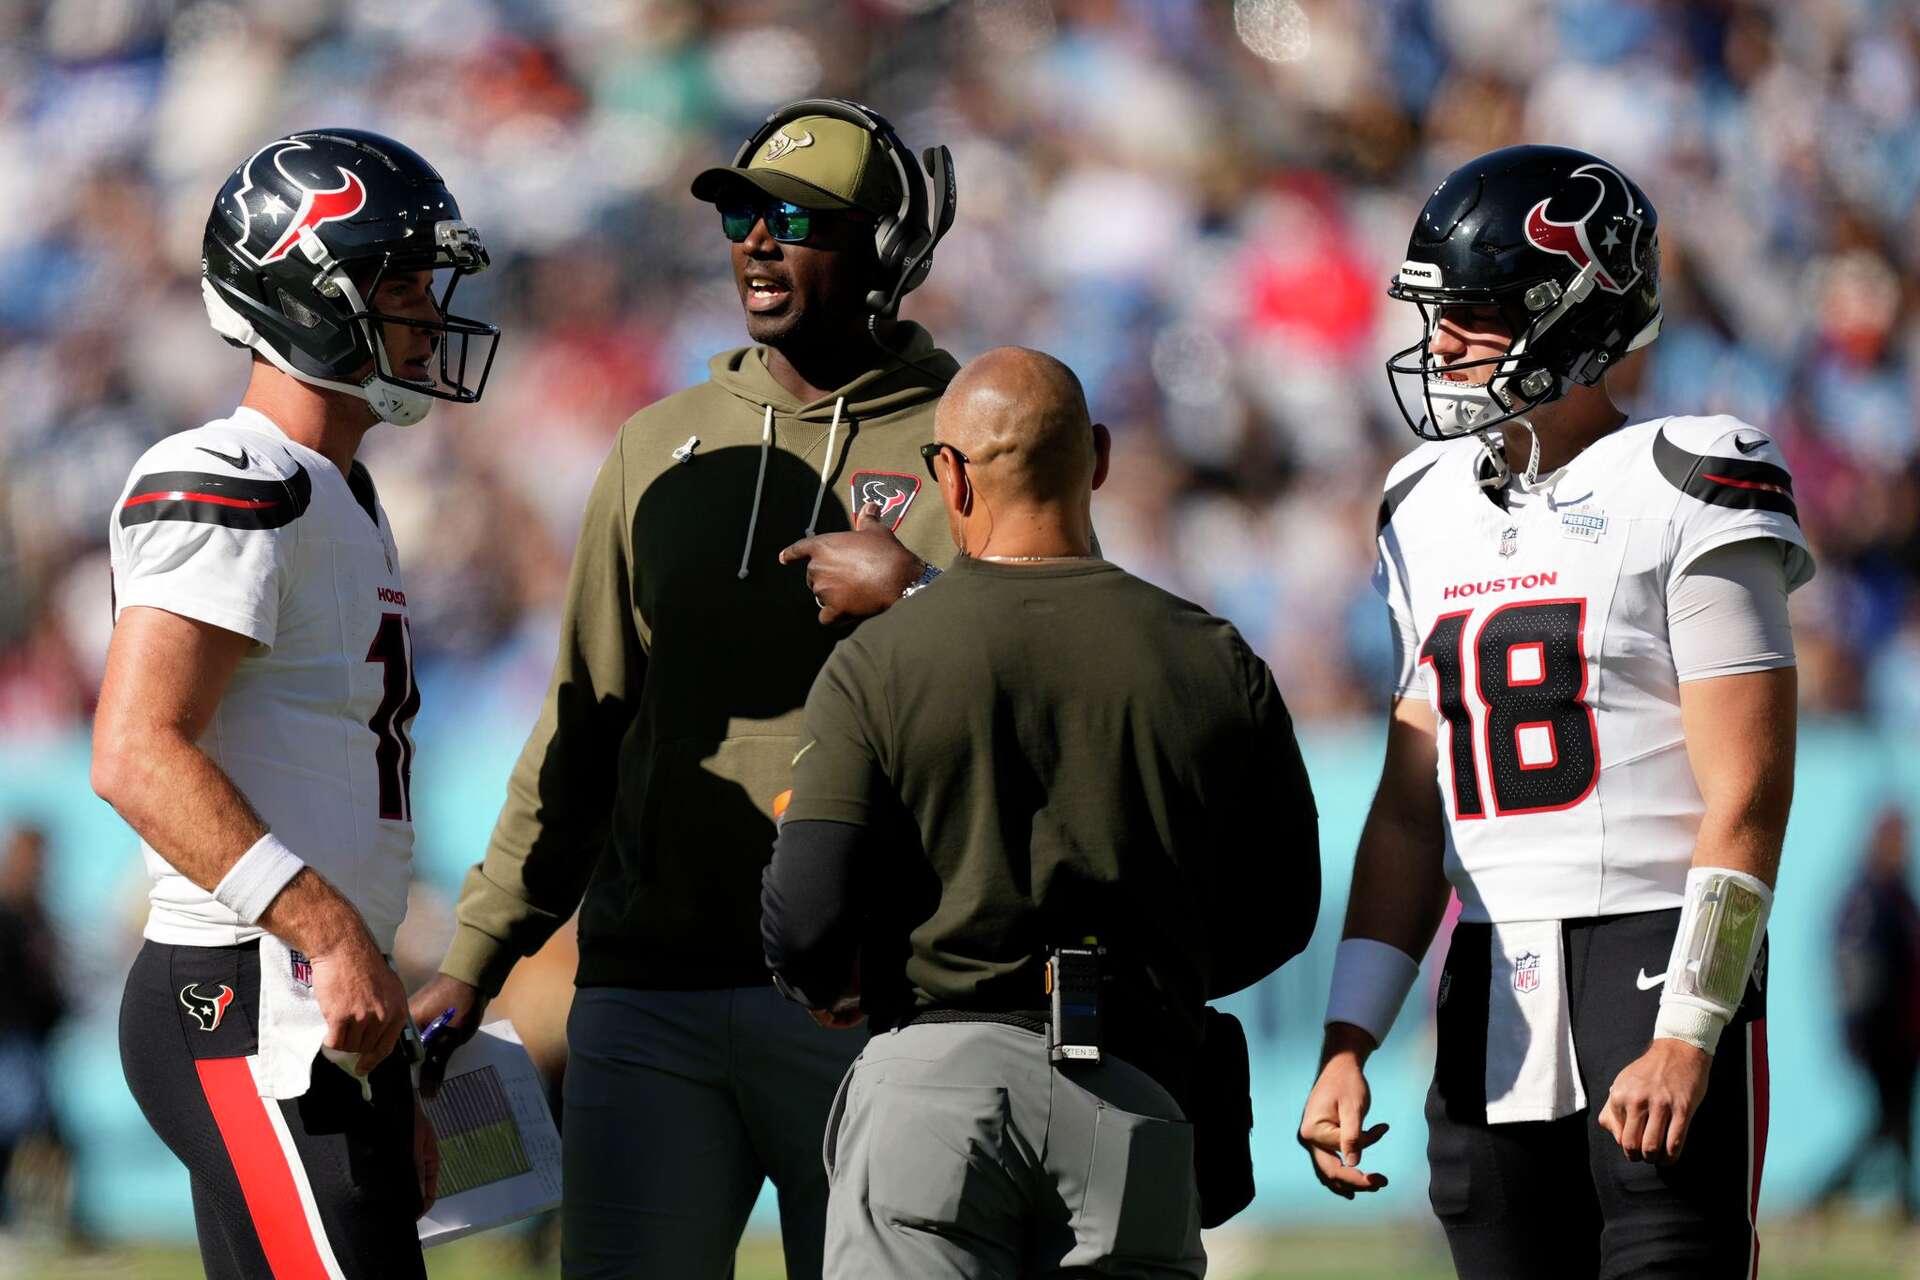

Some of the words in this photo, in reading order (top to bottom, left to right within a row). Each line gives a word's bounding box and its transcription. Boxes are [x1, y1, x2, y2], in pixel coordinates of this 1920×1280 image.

[903, 256, 932, 270] SY
[1563, 513, 1603, 528] PREMIERE
[1444, 571, 1558, 599] HOUSTON
[1417, 597, 1601, 821] 18
[294, 964, 313, 984] NF
[1517, 969, 1538, 988] NFL
